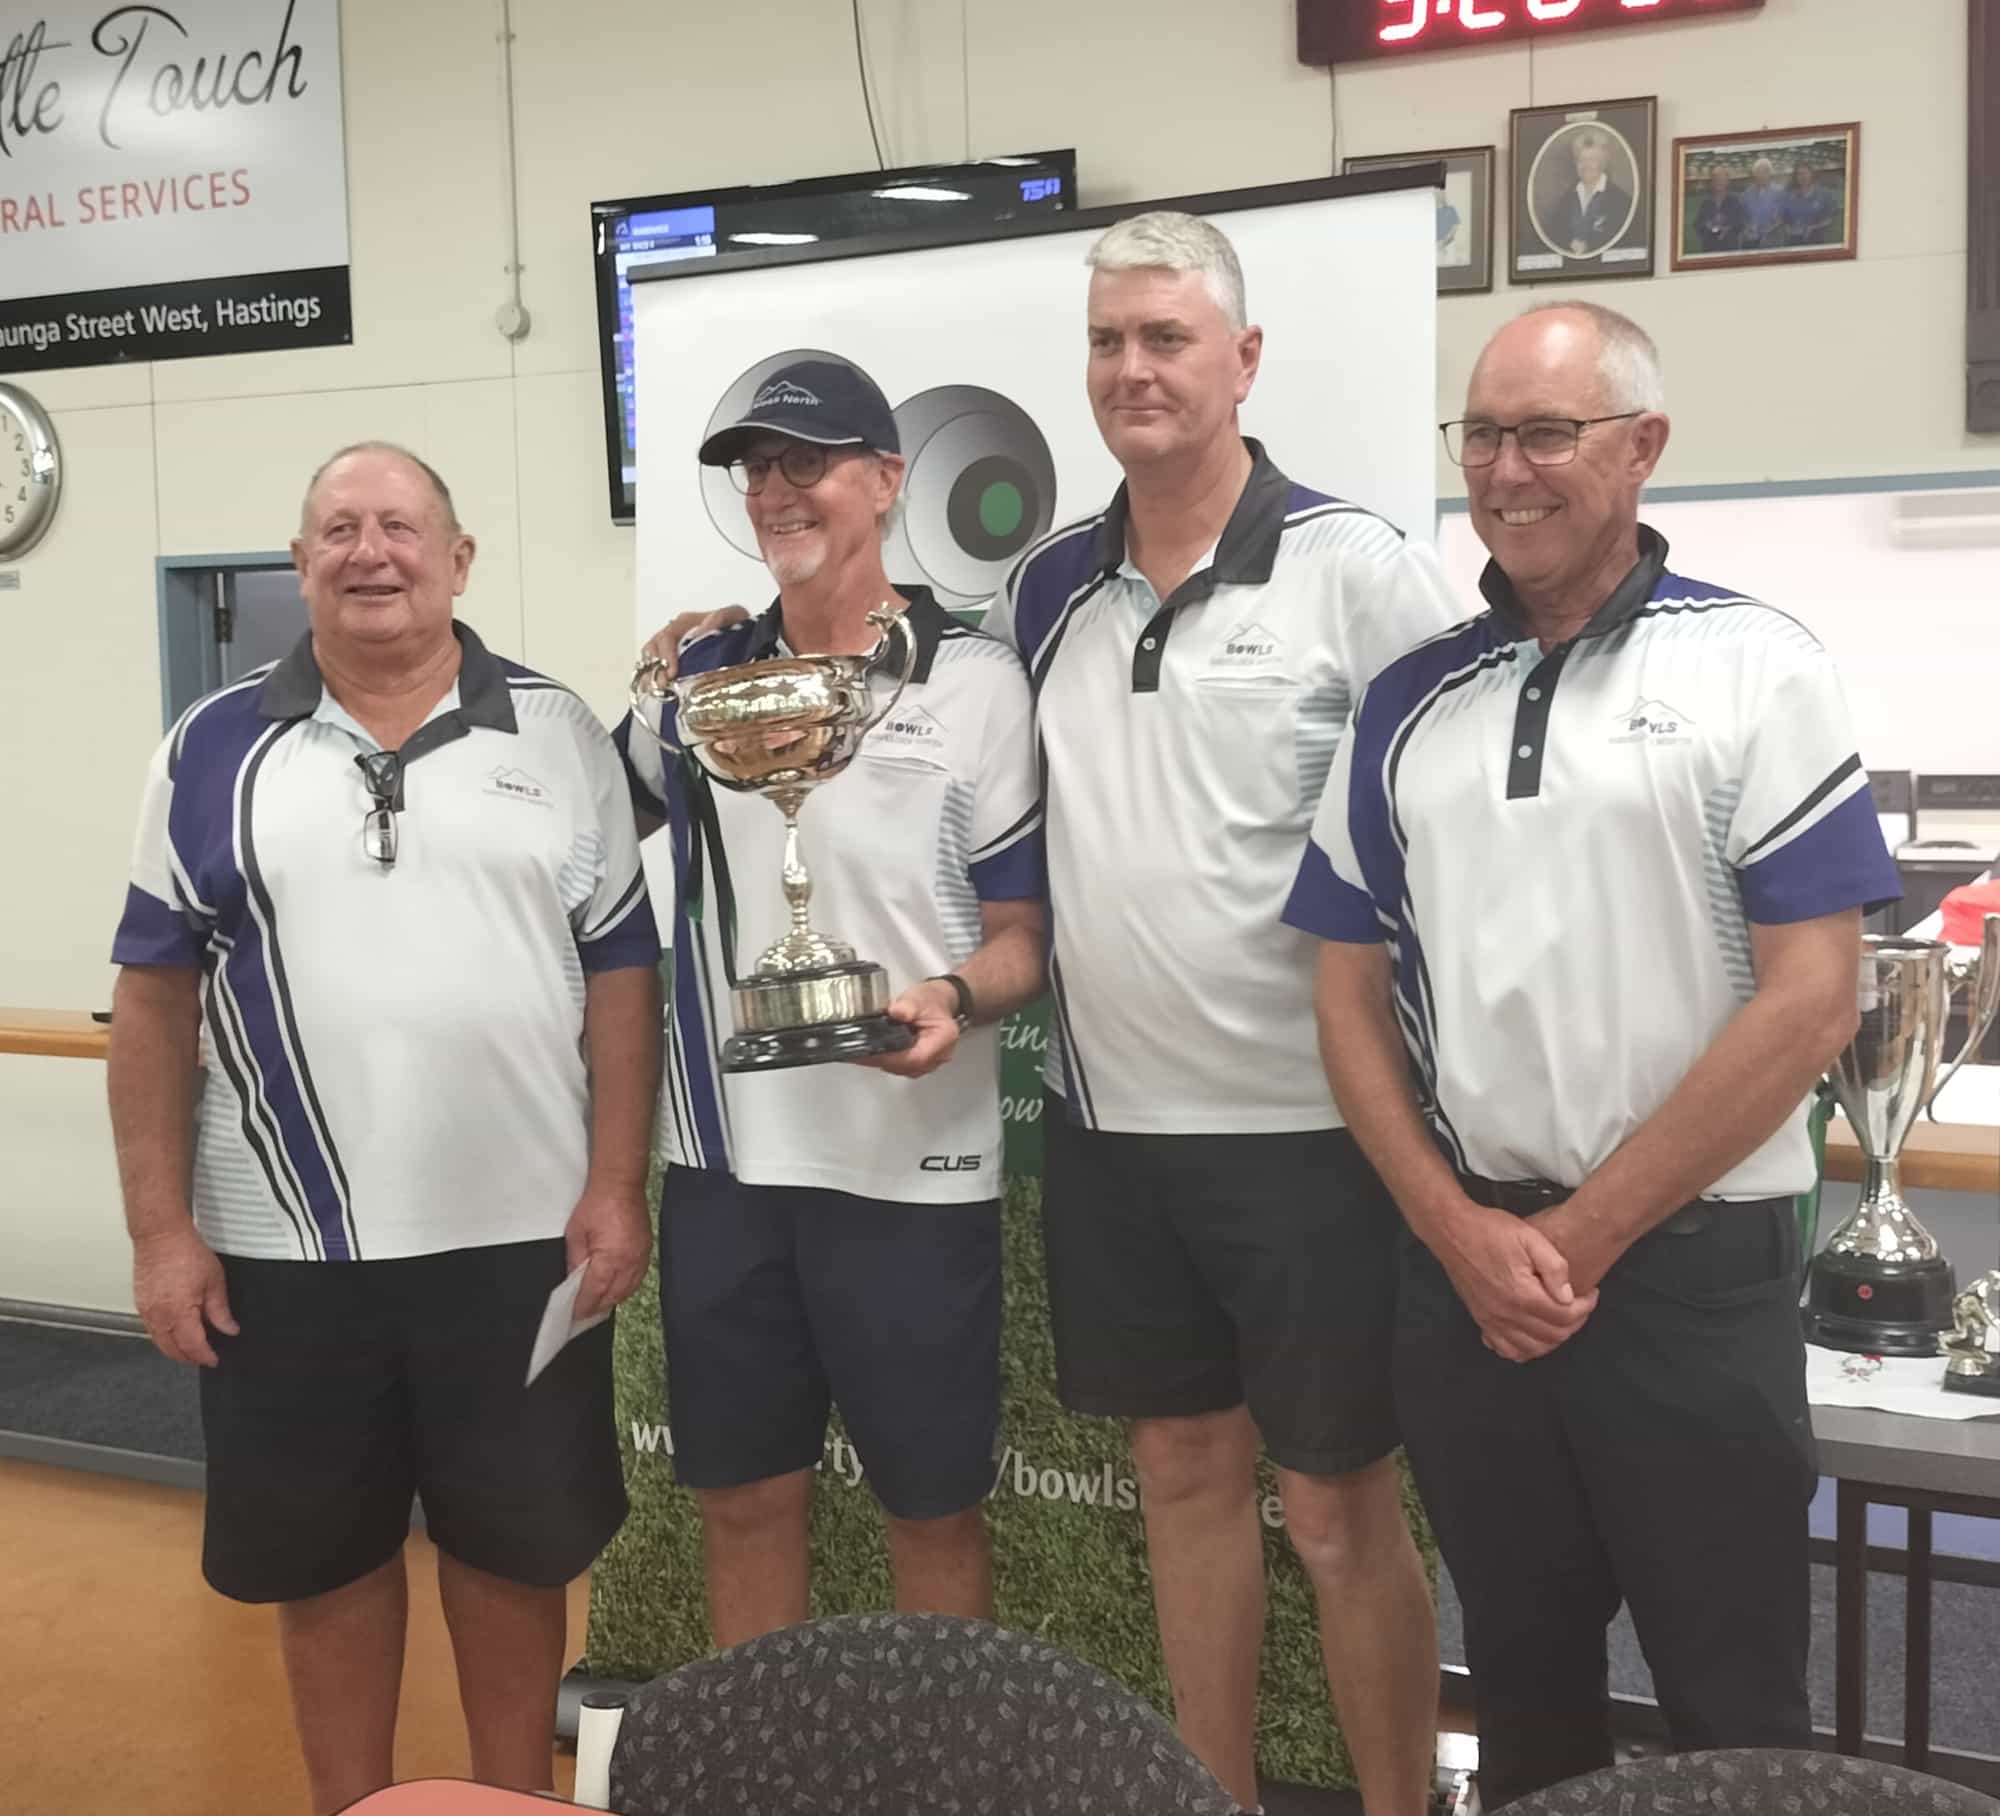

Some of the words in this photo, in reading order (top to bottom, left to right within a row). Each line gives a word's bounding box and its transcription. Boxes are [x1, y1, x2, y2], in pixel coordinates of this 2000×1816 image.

[92, 0, 308, 150] Touch
[0, 191, 65, 233] RAL
[77, 168, 251, 224] SERVICES
[66, 310, 136, 341] Street
[141, 303, 209, 333] West,
[216, 293, 321, 328] Hastings
[919, 1154, 982, 1172] CUS
